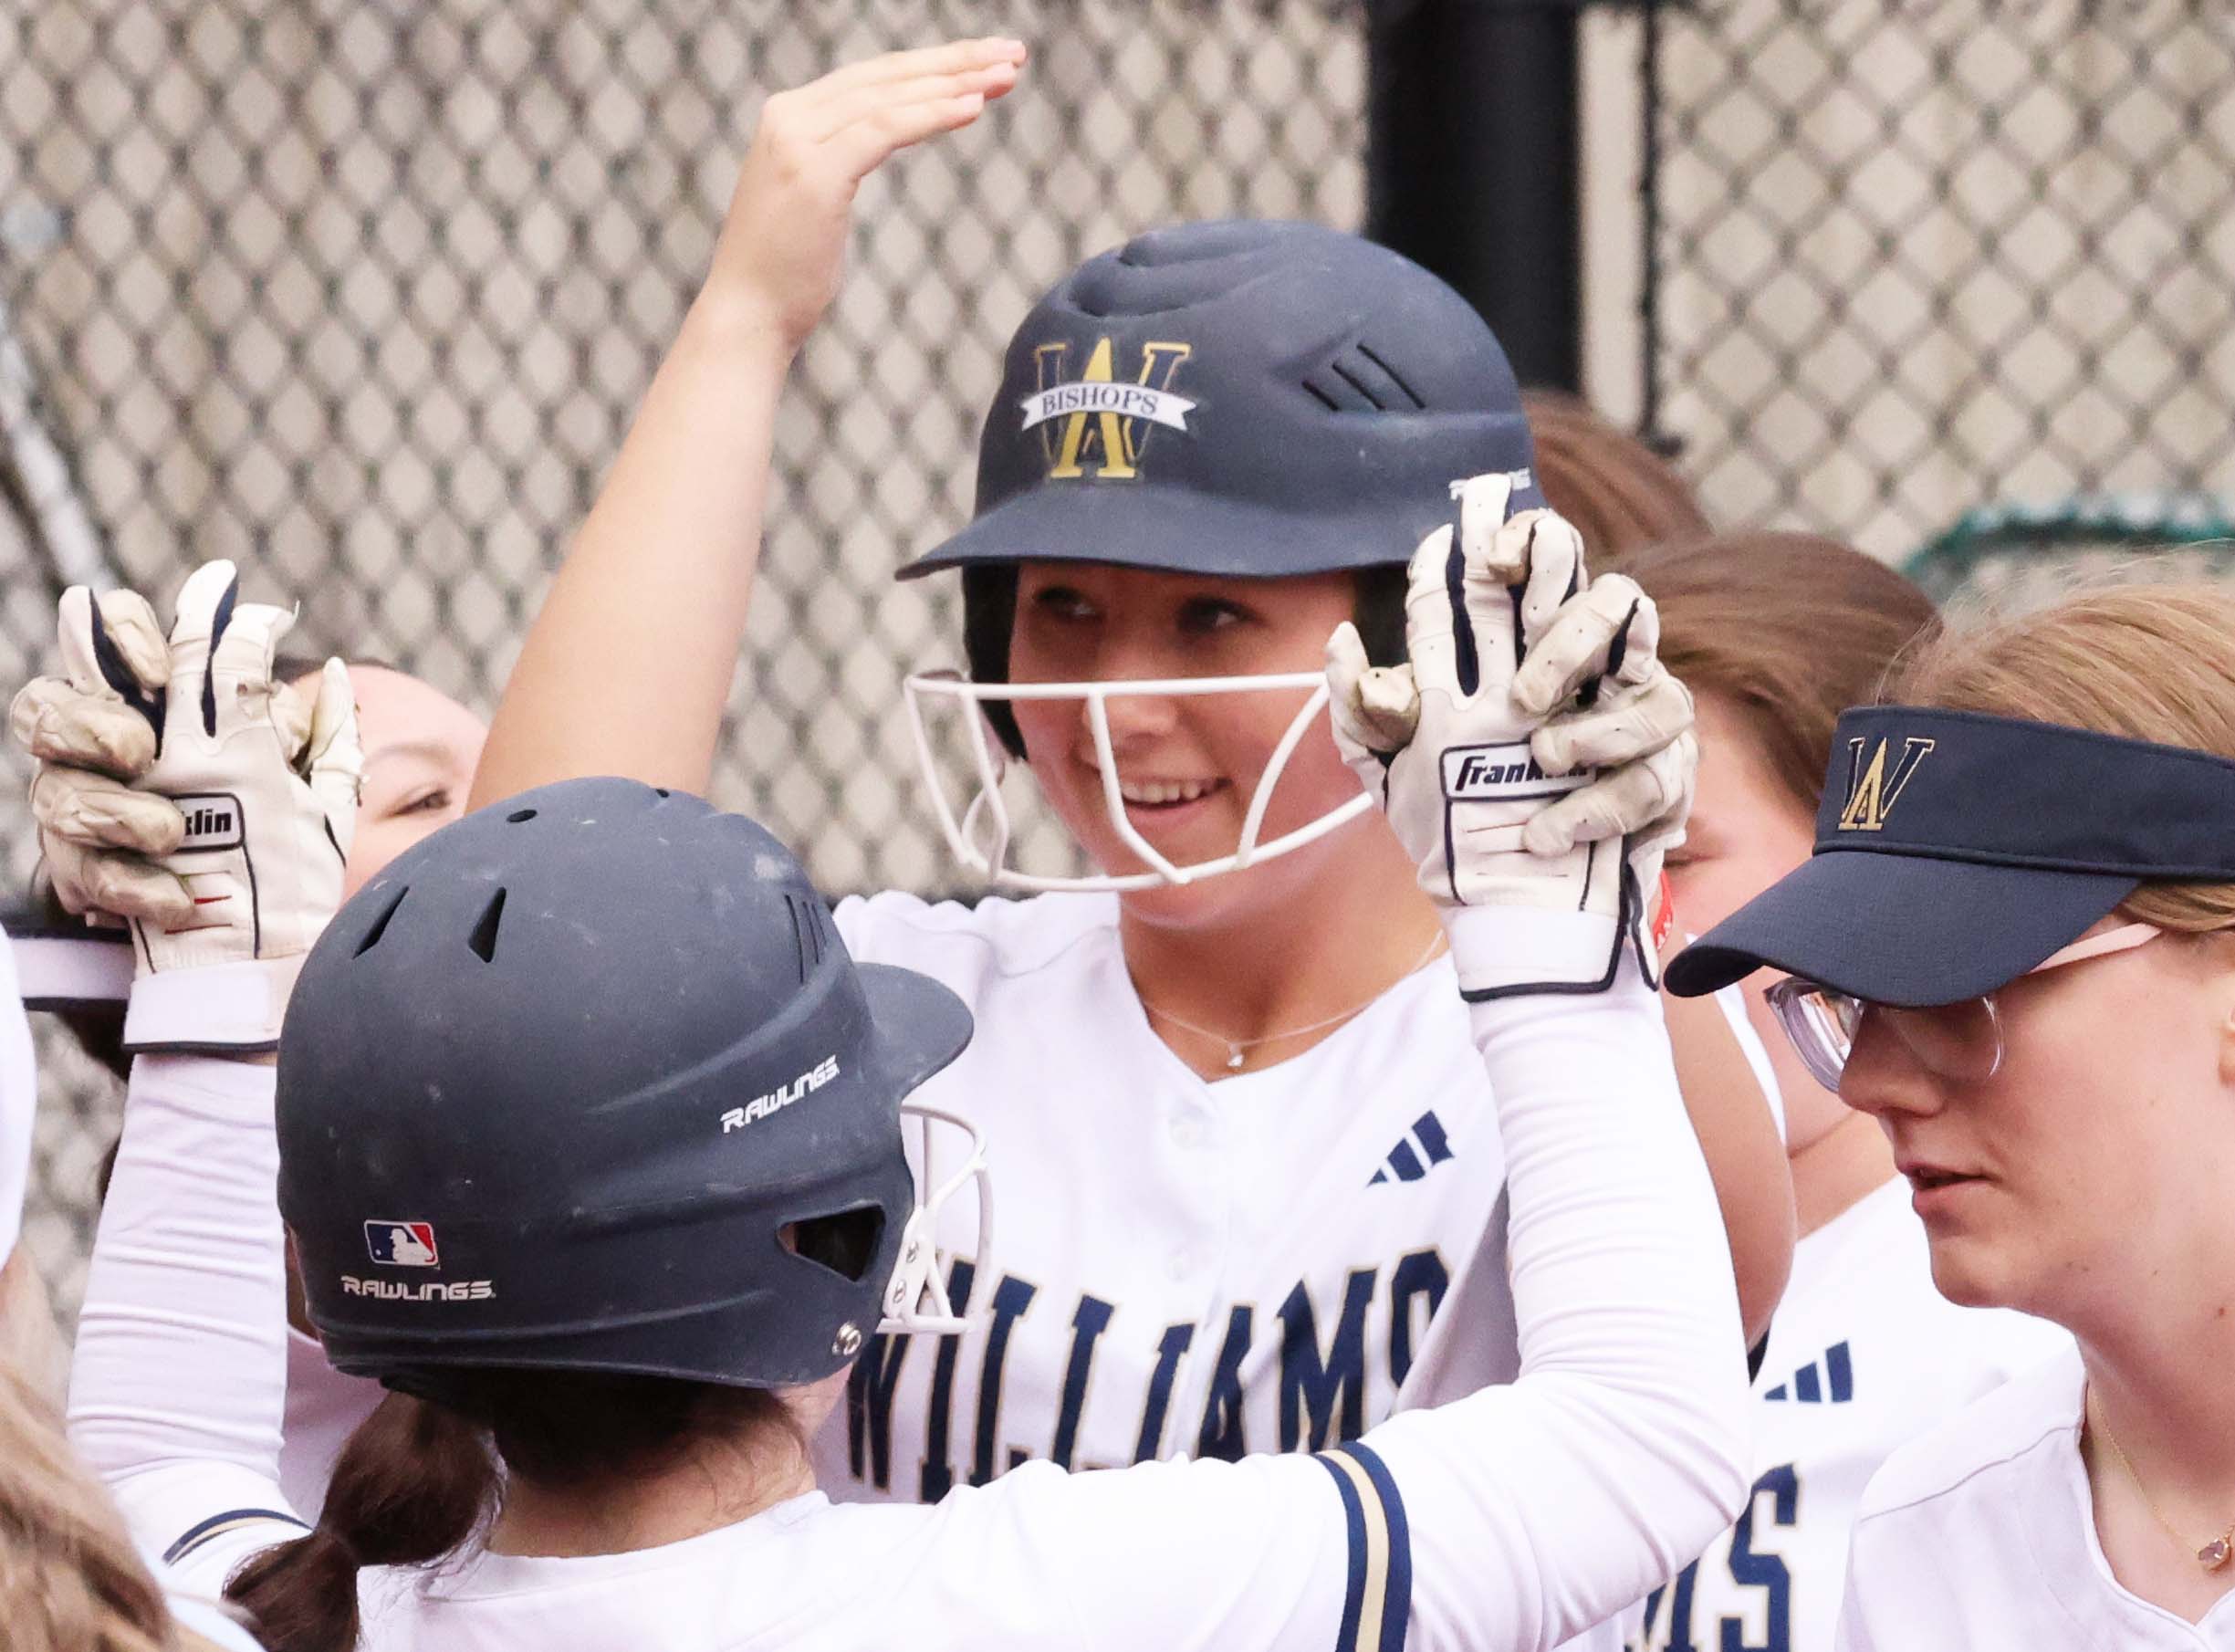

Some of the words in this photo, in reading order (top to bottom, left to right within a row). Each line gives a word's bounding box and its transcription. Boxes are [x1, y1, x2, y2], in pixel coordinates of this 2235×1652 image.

[1041, 386, 1159, 416] BISHOPS
[1455, 756, 1588, 791] Frank
[719, 1054, 841, 1134] RAWLINGS
[340, 1275, 493, 1302] RAWLINGS
